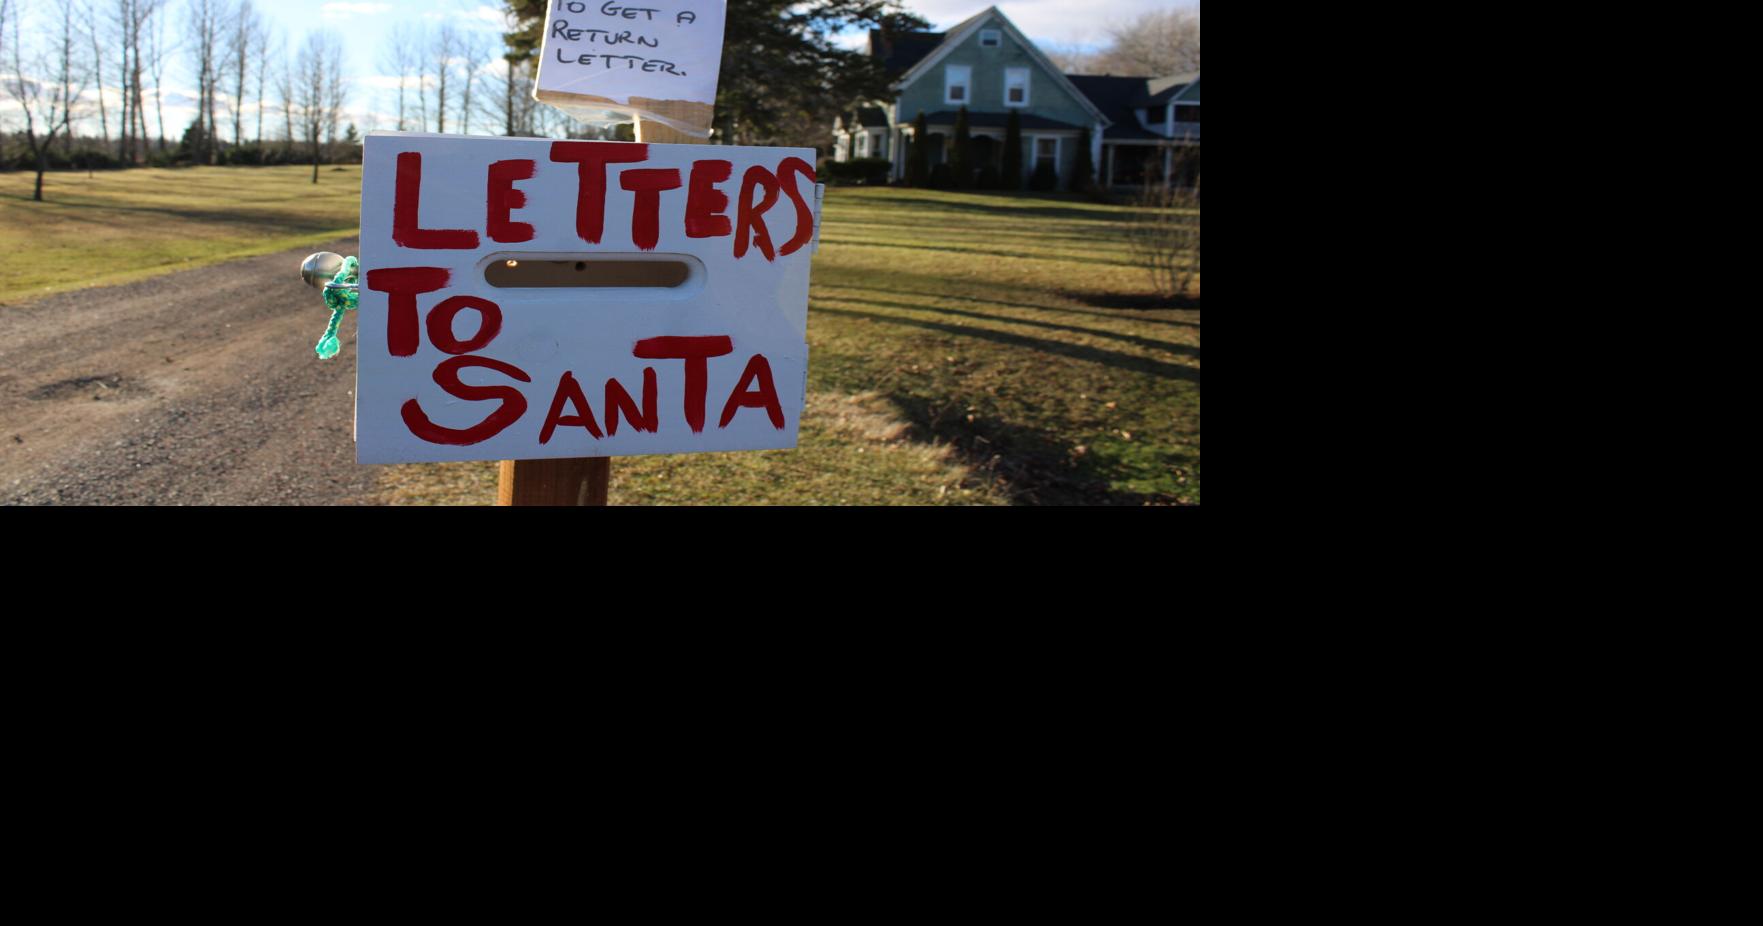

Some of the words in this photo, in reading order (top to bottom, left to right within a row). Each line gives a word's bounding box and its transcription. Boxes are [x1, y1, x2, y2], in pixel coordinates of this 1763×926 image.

[551, 19, 659, 48] RETURN
[600, 0, 661, 21] GET
[676, 10, 697, 25] A
[556, 48, 687, 77] LETTER.
[392, 141, 817, 262] LETTERS
[367, 267, 502, 357] TO
[401, 335, 785, 446] SANTA
